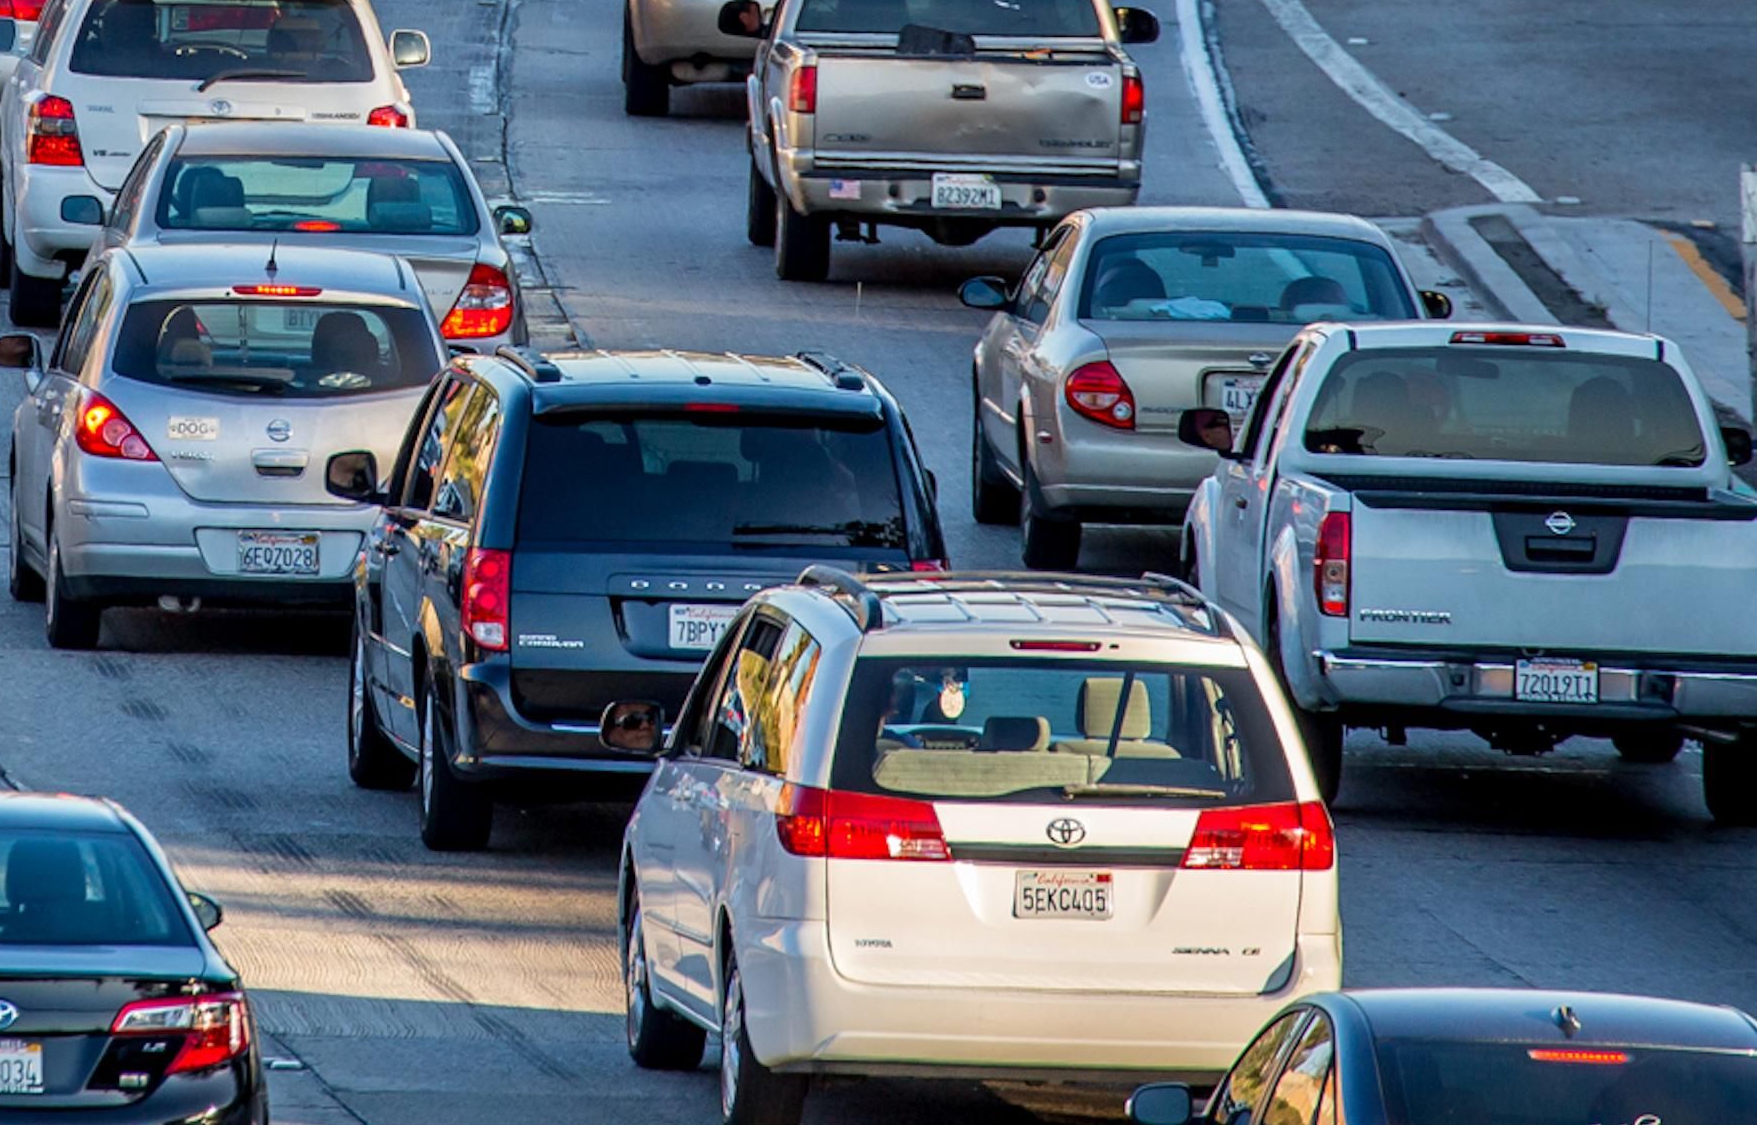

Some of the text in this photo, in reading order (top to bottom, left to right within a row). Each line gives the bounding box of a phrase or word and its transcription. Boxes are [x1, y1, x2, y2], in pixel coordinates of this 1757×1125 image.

[936, 186, 997, 207] 82392M1
[176, 421, 209, 435] DOG
[243, 546, 314, 568] 6EQZ028
[1359, 608, 1452, 625] FRONTIER
[1036, 873, 1093, 888] California
[1022, 887, 1106, 912] 5EKC405
